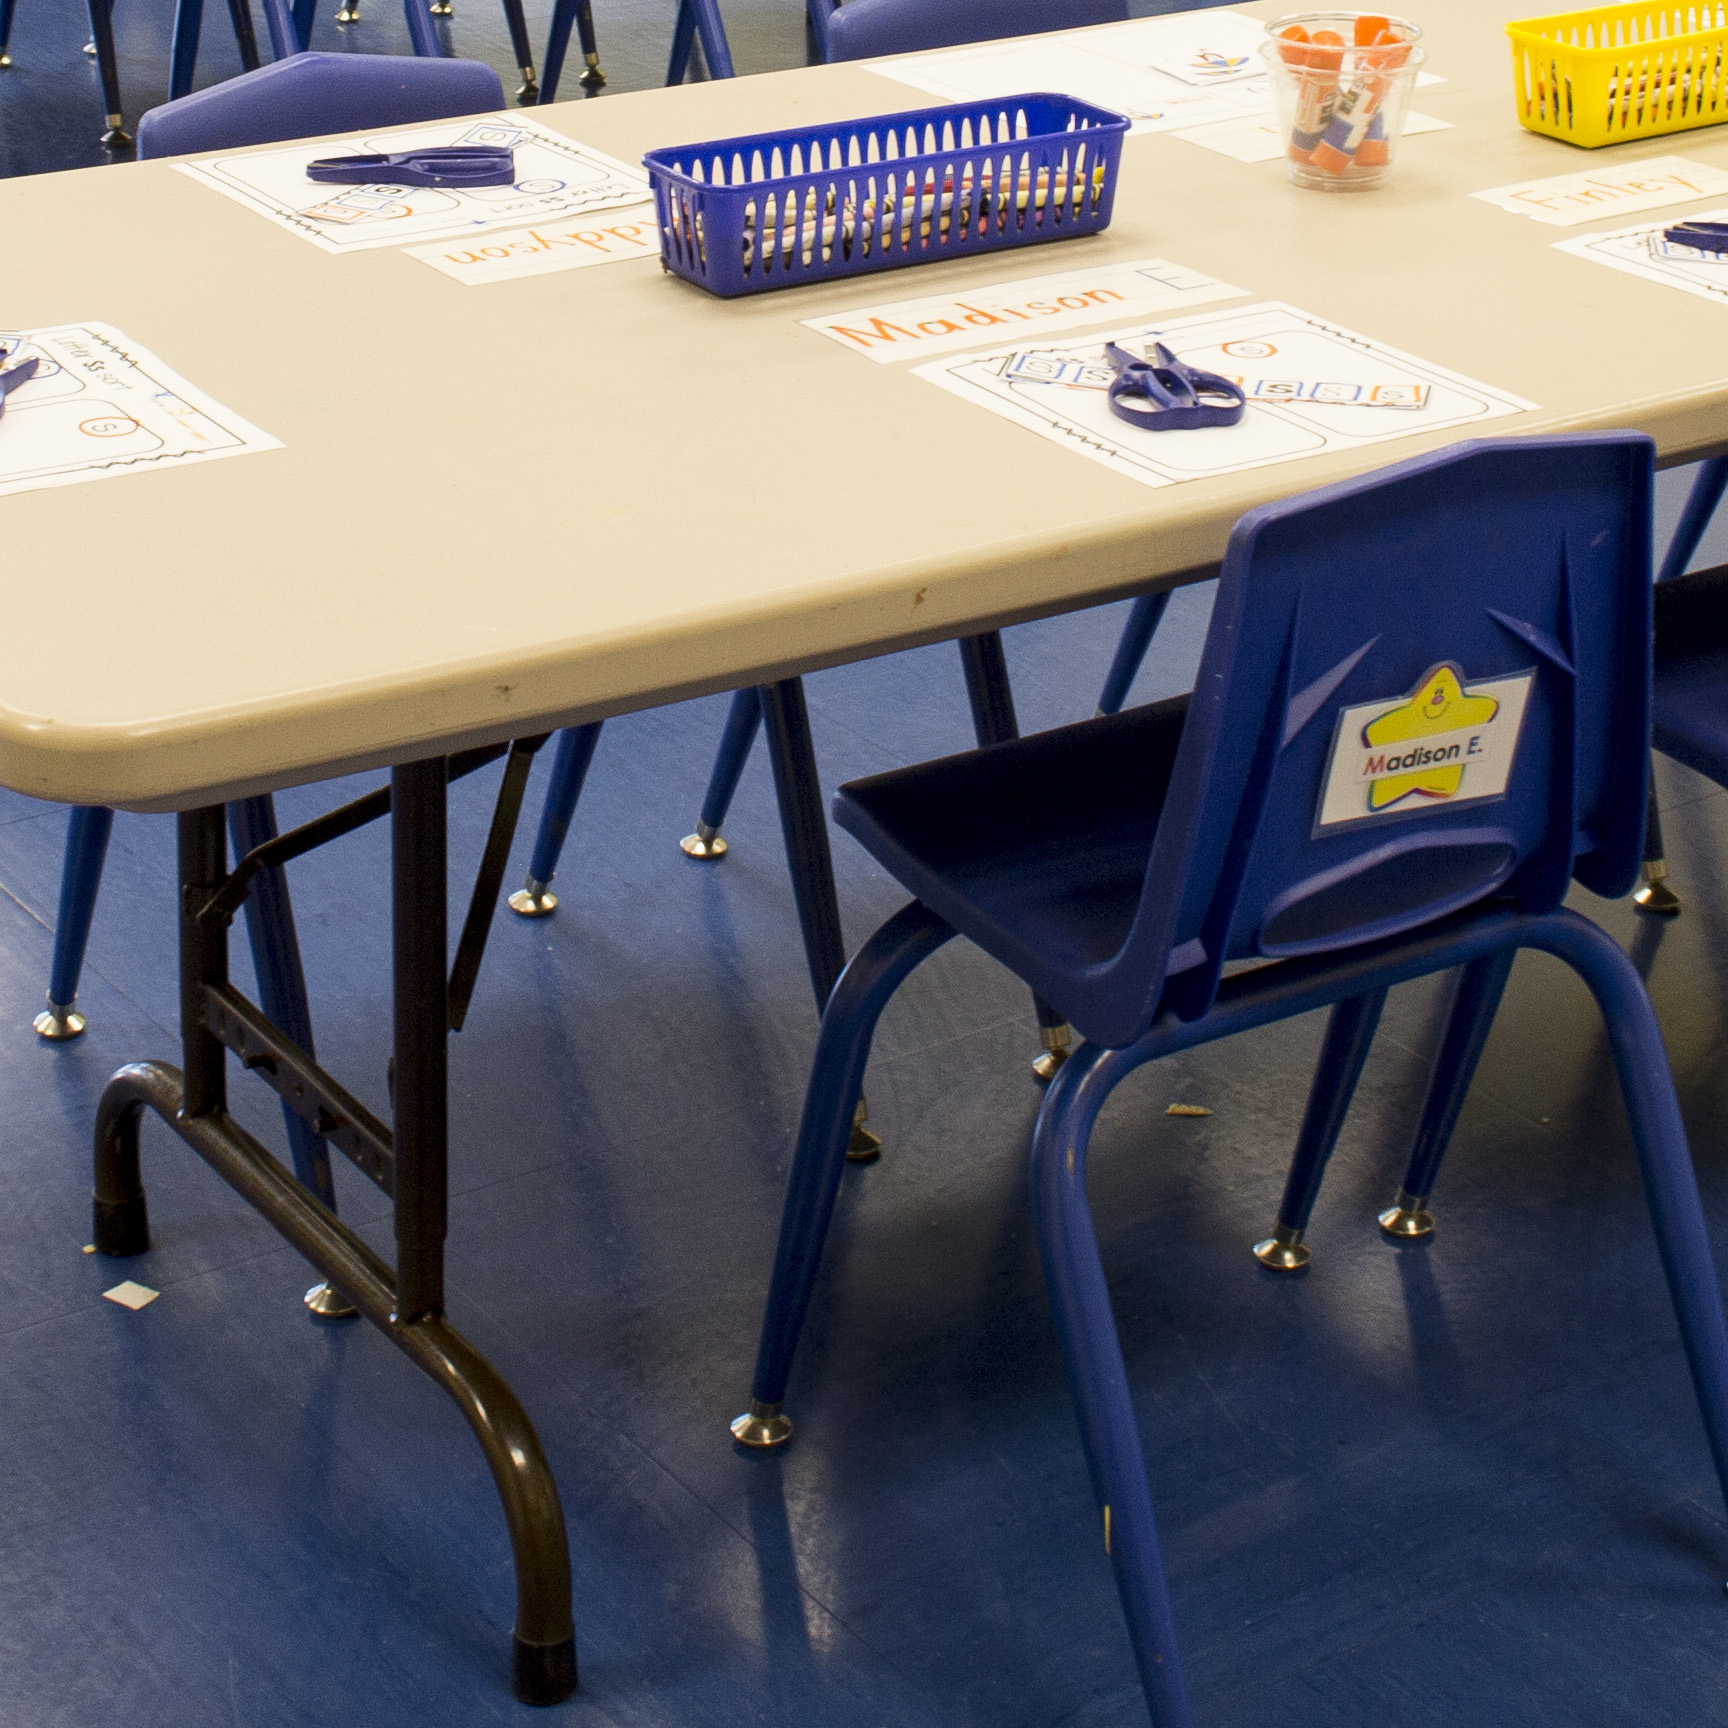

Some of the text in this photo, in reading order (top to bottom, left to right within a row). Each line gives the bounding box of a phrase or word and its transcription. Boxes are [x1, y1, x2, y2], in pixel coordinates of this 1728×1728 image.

[1507, 174, 1705, 212] Finley
[828, 266, 1216, 348] Madison E.
[1362, 735, 1484, 777] Madison E.
